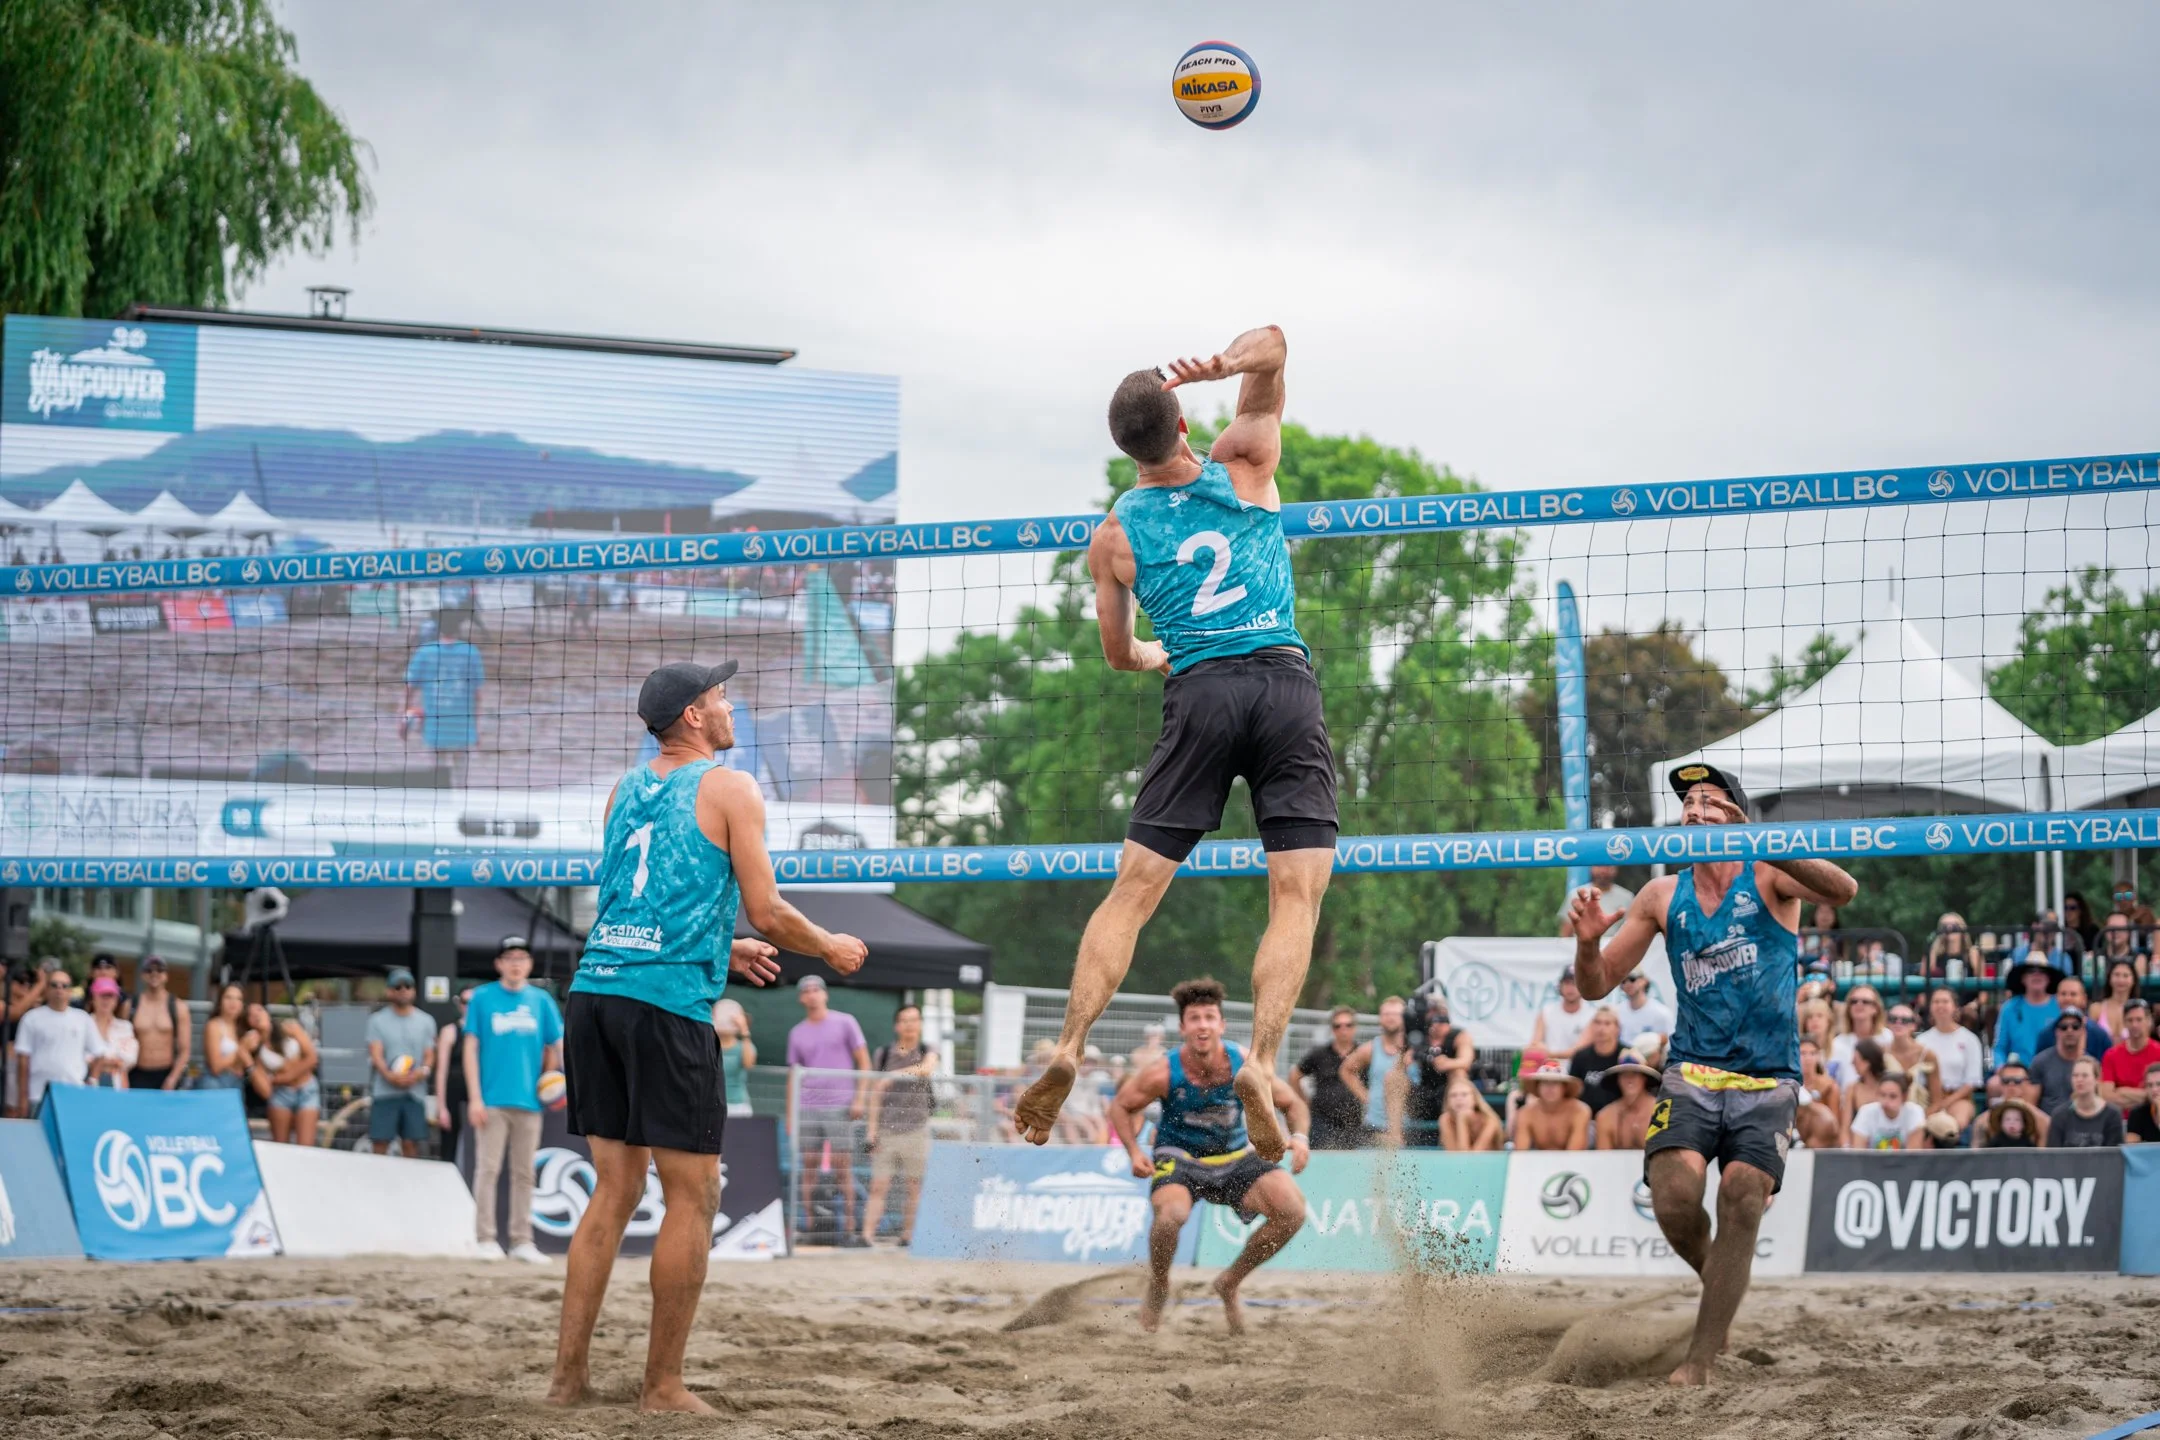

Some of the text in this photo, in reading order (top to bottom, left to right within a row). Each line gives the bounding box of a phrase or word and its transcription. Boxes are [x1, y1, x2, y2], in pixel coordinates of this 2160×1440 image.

[1180, 57, 1237, 73] BEACH PRO
[29, 362, 166, 402] VANCOUVER
[39, 561, 221, 591] VOLLEYBALLBC
[268, 549, 463, 580] VOLLEYBALLBC
[512, 538, 720, 570] VOLLEYBALLBC
[773, 523, 993, 558] VOLLEYBALLBC
[1339, 492, 1585, 528] VOLLEYBALLBC
[1644, 474, 1900, 511] VOLLEYBALLBC
[1963, 458, 2160, 494] VOLLEYBAL
[1176, 530, 1248, 617] 2
[60, 797, 196, 825] NATURA
[28, 861, 208, 883] VOLLEYBALLBC
[257, 859, 450, 882] VOLLEYBALLBC
[501, 858, 603, 881] VOLLEY
[1335, 836, 1578, 868] VOLLEYBALLBC
[1642, 825, 1896, 858] VOLLEYBALLBC
[1961, 815, 2160, 848] VOLLEYBAL
[625, 821, 655, 898] 1
[1677, 910, 1687, 929] 1
[1682, 942, 1758, 981] VANCOUVER
[145, 1134, 222, 1153] VOLLEYBALL
[150, 1153, 237, 1229] BC
[971, 1193, 1148, 1233] VANCOUVER
